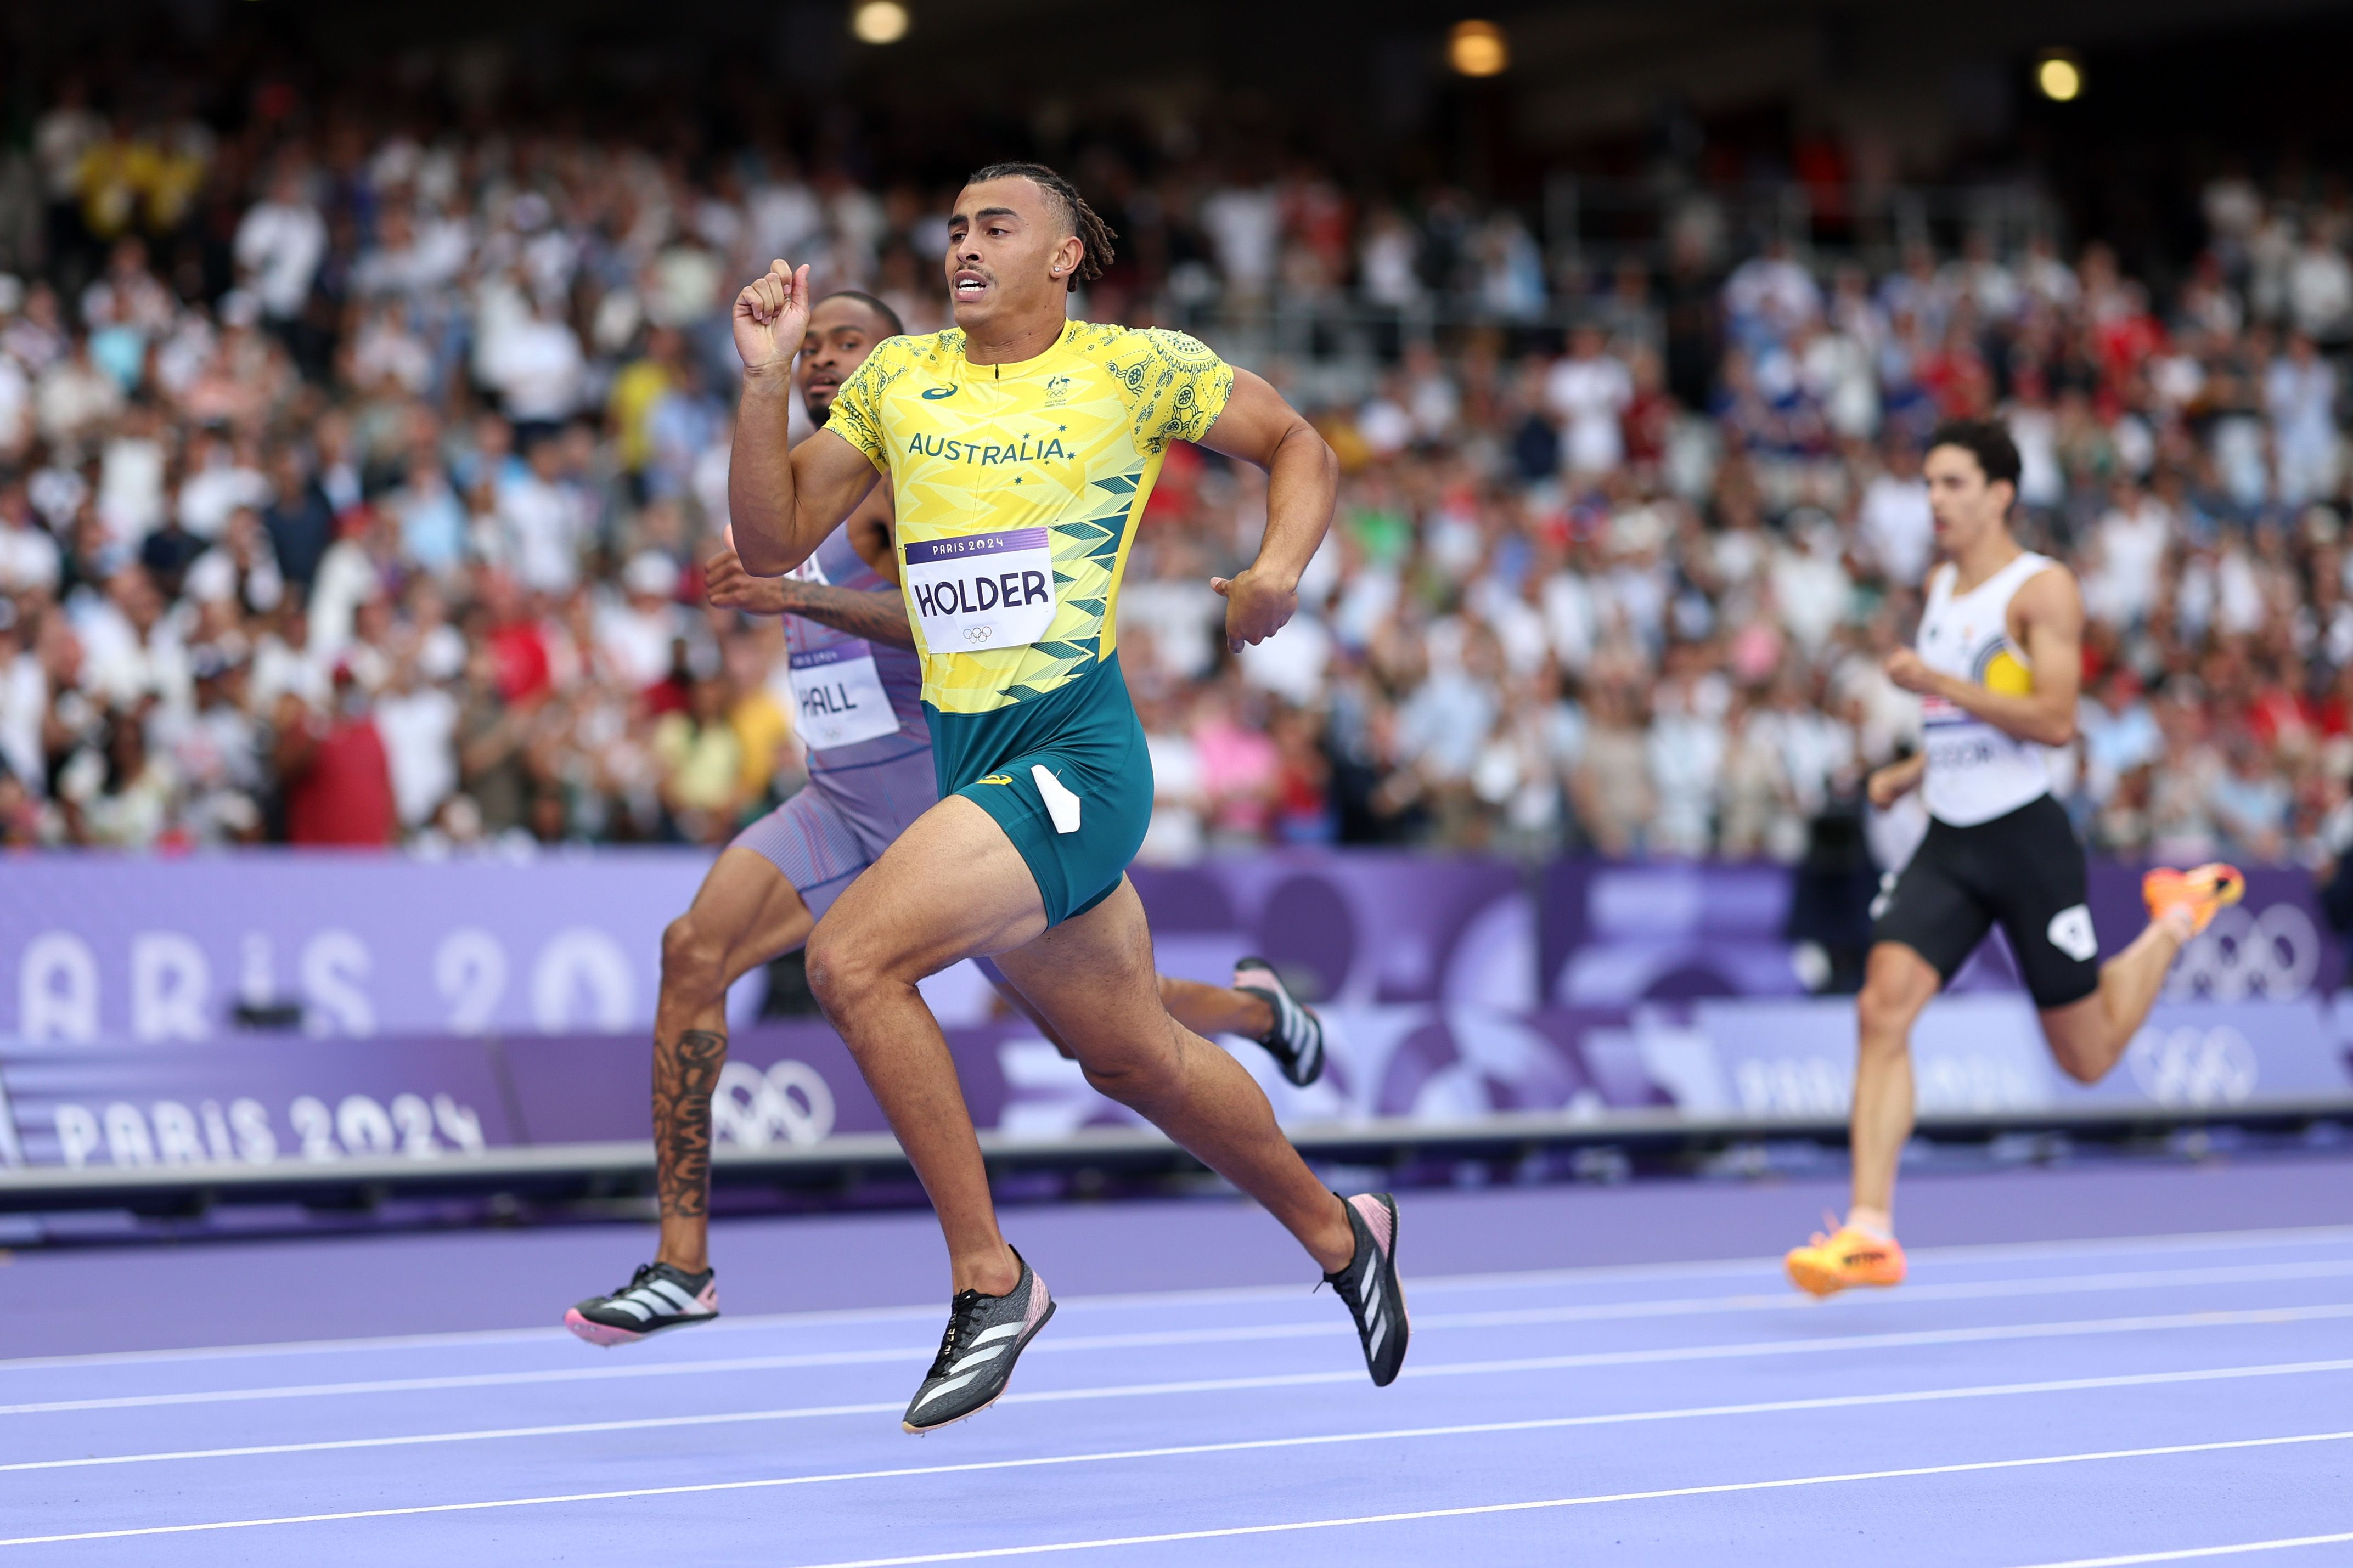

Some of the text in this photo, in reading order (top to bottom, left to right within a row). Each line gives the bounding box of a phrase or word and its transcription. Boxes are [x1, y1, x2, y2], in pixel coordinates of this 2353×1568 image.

[908, 432, 1065, 466] AUSTRALIA
[968, 537, 1004, 551] 2024
[914, 570, 1049, 617] HOLDER
[798, 682, 858, 717] HALL
[289, 1092, 485, 1164] 2024
